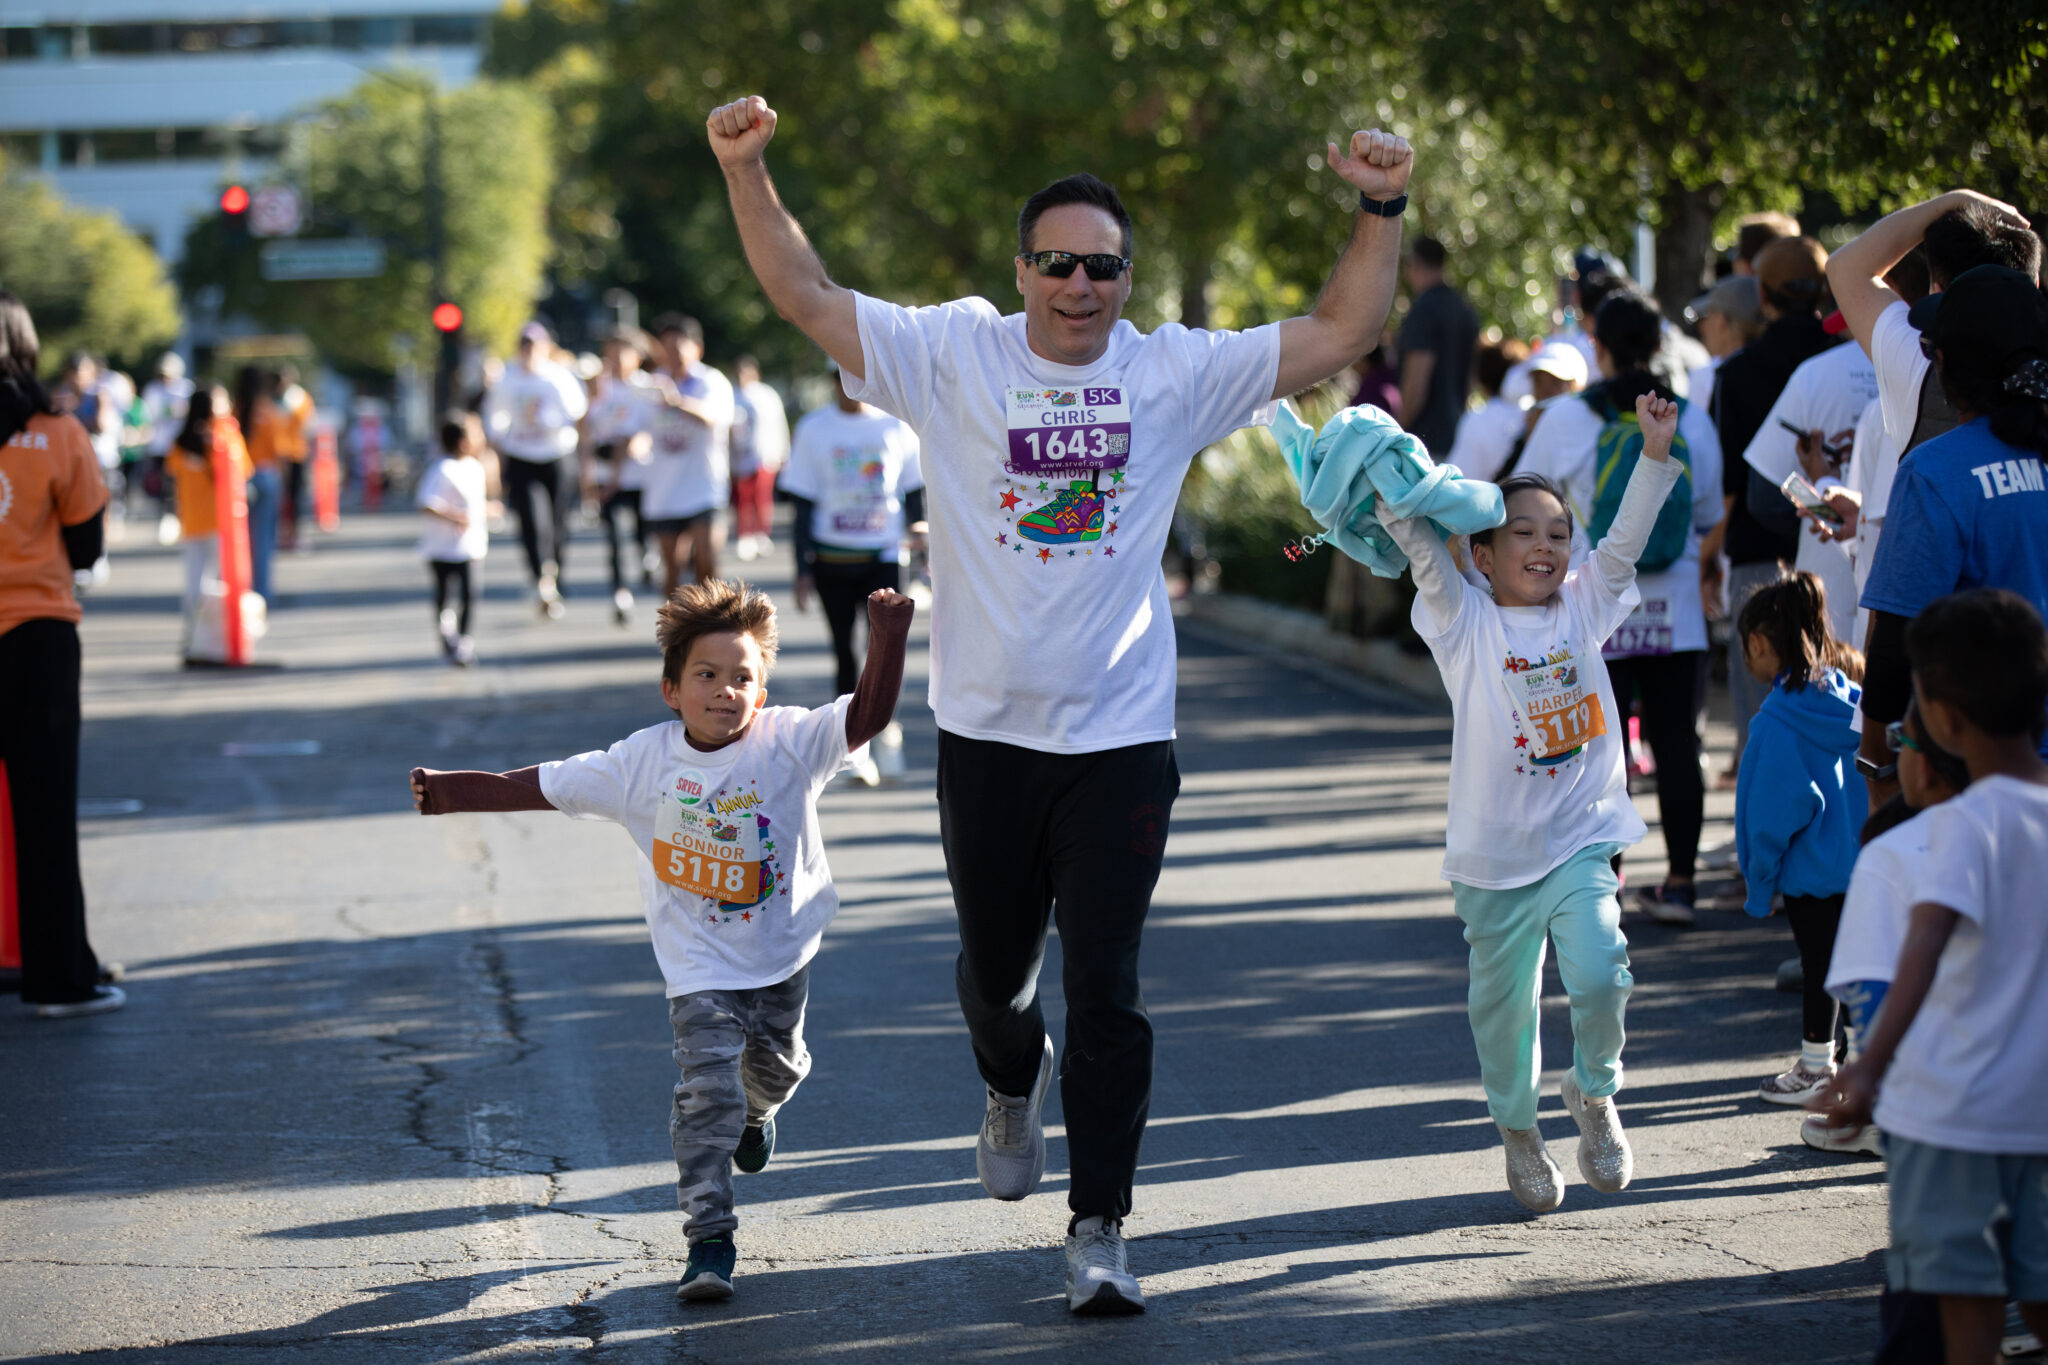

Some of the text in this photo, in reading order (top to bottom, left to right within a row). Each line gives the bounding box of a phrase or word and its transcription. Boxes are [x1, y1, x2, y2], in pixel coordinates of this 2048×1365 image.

[1089, 389, 1117, 404] 5K
[1041, 409, 1097, 426] CHRIS
[1024, 427, 1109, 461] 1643
[1040, 460, 1104, 469] www.srvef.org
[1970, 458, 2046, 500] TEAM
[1527, 685, 1585, 715] HARPER
[676, 777, 703, 798] SRVEA
[715, 789, 764, 816] ANNUAL
[672, 832, 744, 861] CONNOR
[668, 848, 745, 893] 5118
[674, 878, 732, 901] www.srvef.org
